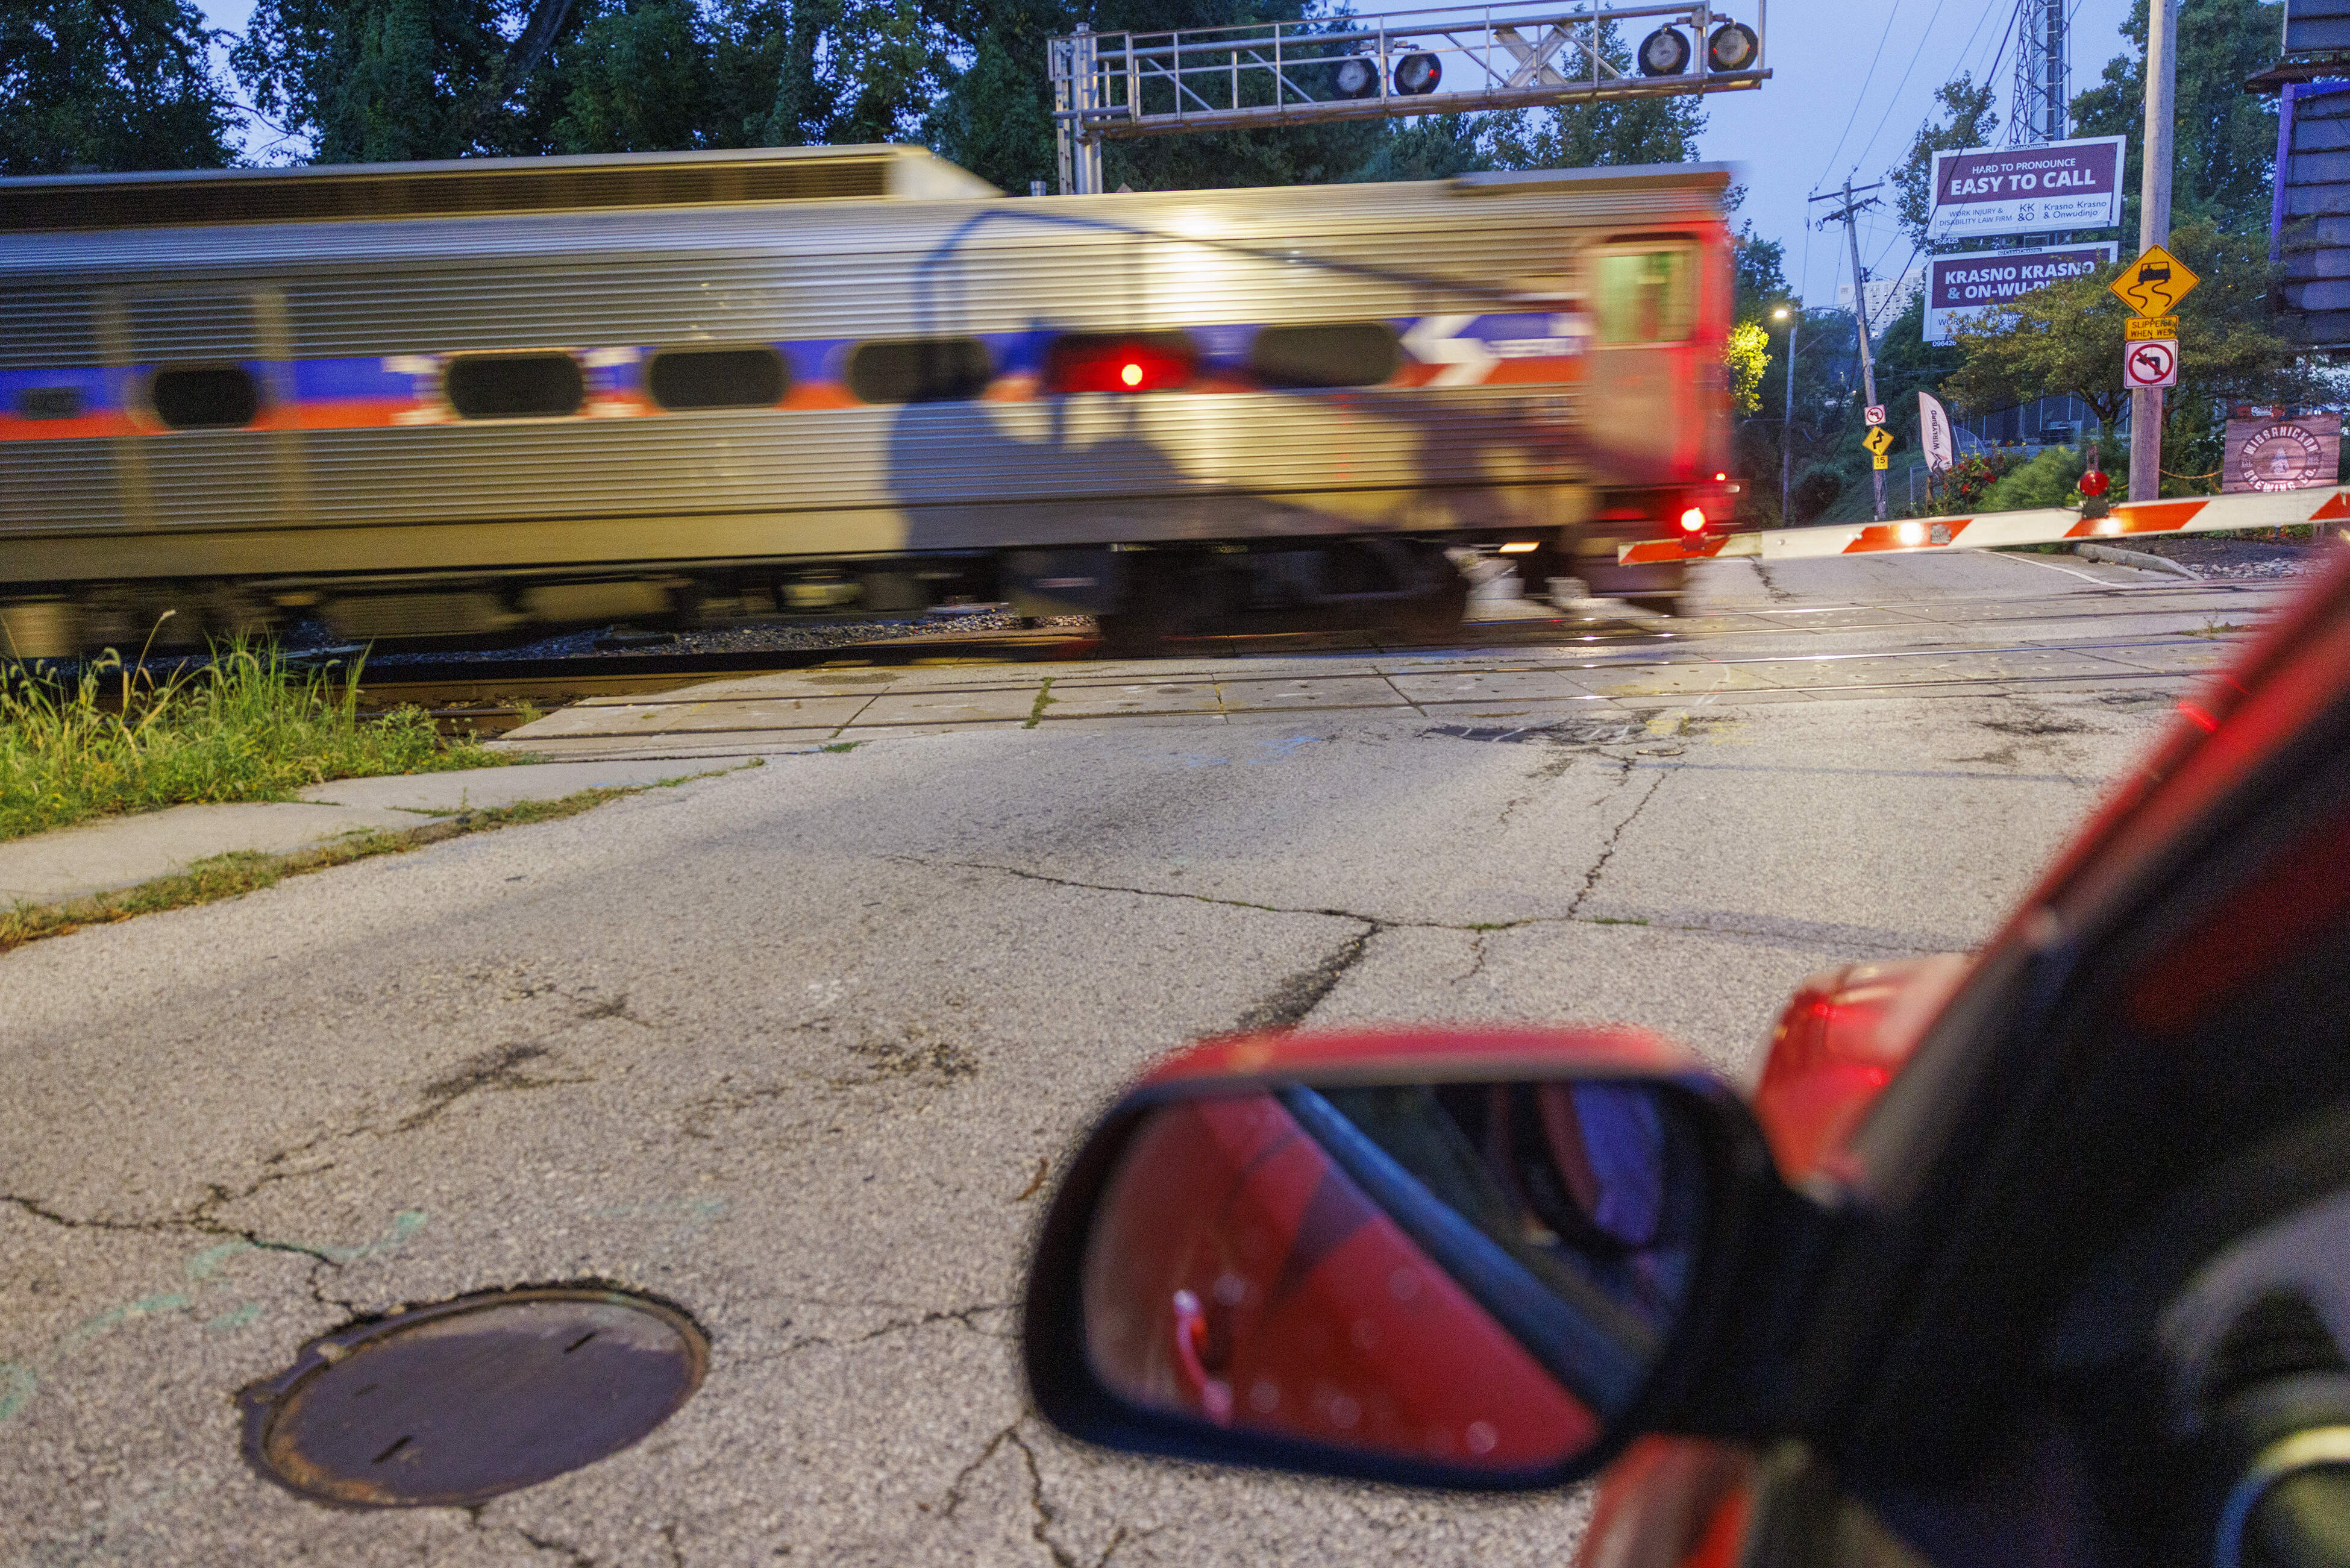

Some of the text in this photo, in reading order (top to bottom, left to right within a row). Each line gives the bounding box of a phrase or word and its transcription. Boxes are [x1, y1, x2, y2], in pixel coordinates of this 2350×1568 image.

[1972, 158, 2076, 174] HARD TO PRONOUNCE
[1950, 169, 2096, 196] EASY TO CALL
[1973, 208, 1996, 216] INJURY
[2020, 202, 2035, 212] KK
[2053, 209, 2098, 218] Onwudinjo
[1940, 218, 1976, 227] DISABILITY
[2017, 212, 2034, 222] &O
[1945, 261, 2095, 284] KRASNO KRASNO
[1947, 287, 1960, 299] &
[1931, 410, 1940, 450] WIRLYBIRD
[2243, 426, 2319, 455] WISSAHICKON
[2243, 469, 2296, 492] BREWING
